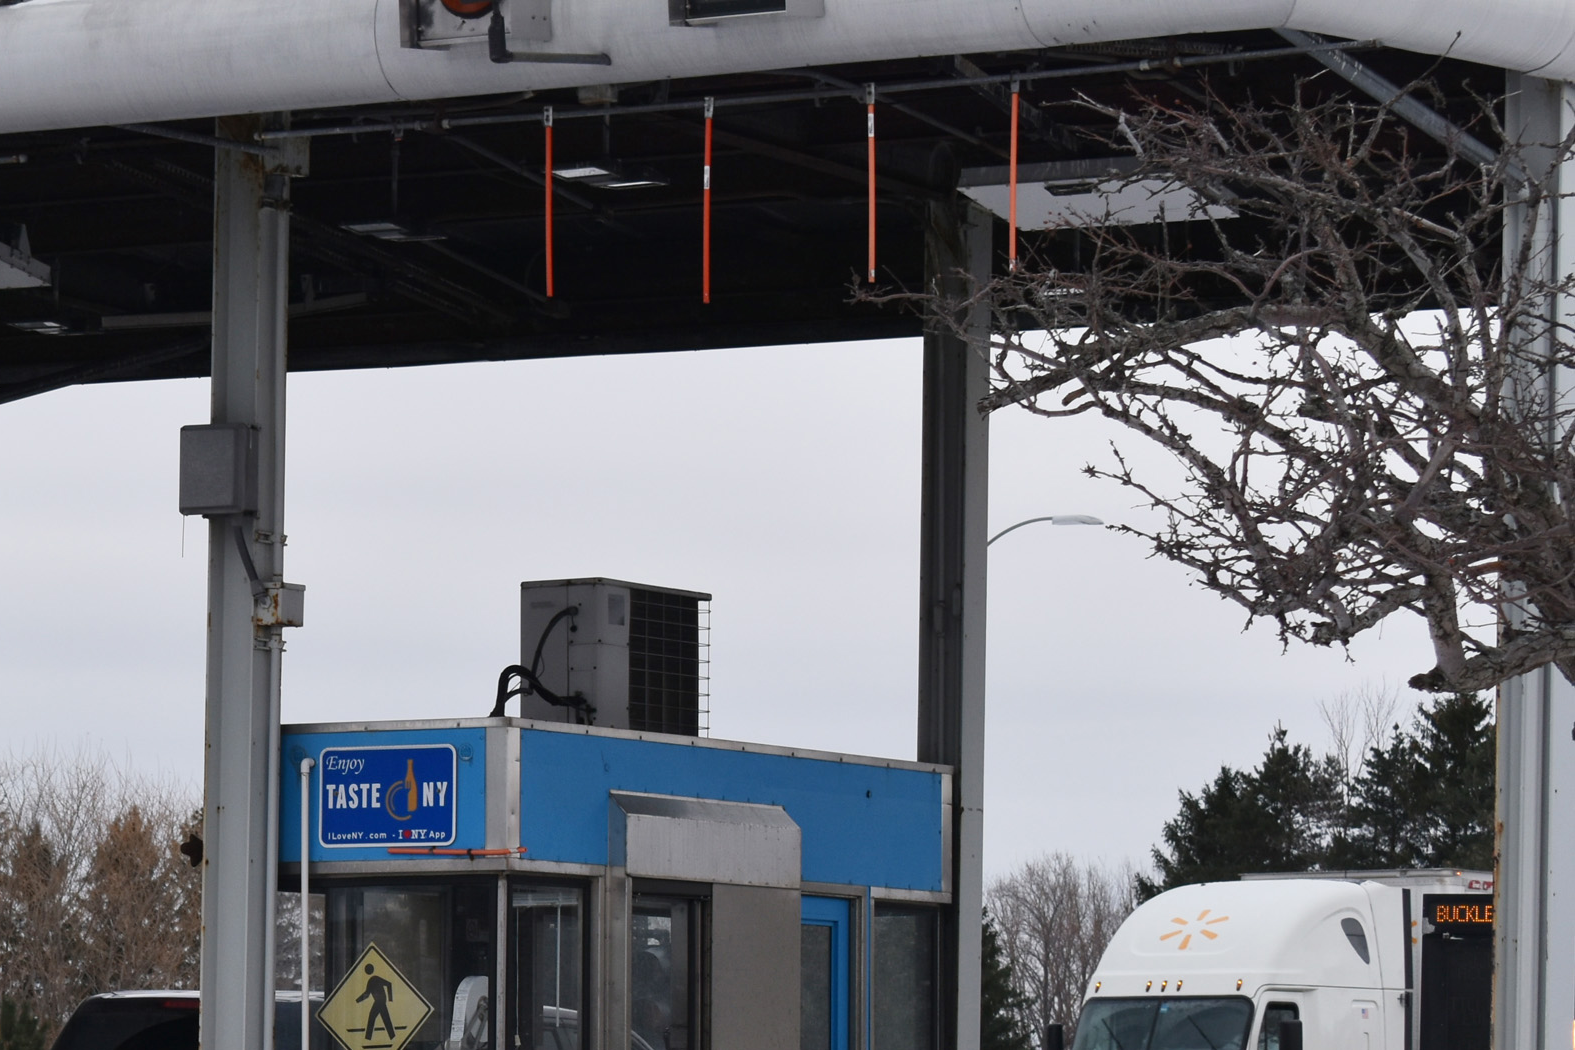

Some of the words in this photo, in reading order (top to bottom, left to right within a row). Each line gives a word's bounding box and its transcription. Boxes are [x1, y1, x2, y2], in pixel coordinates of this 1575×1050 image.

[326, 755, 365, 775] Enjoy
[326, 783, 381, 809] TASTE
[422, 781, 448, 807] NY
[429, 830, 446, 839] App
[1436, 905, 1493, 922] BUCKLE
